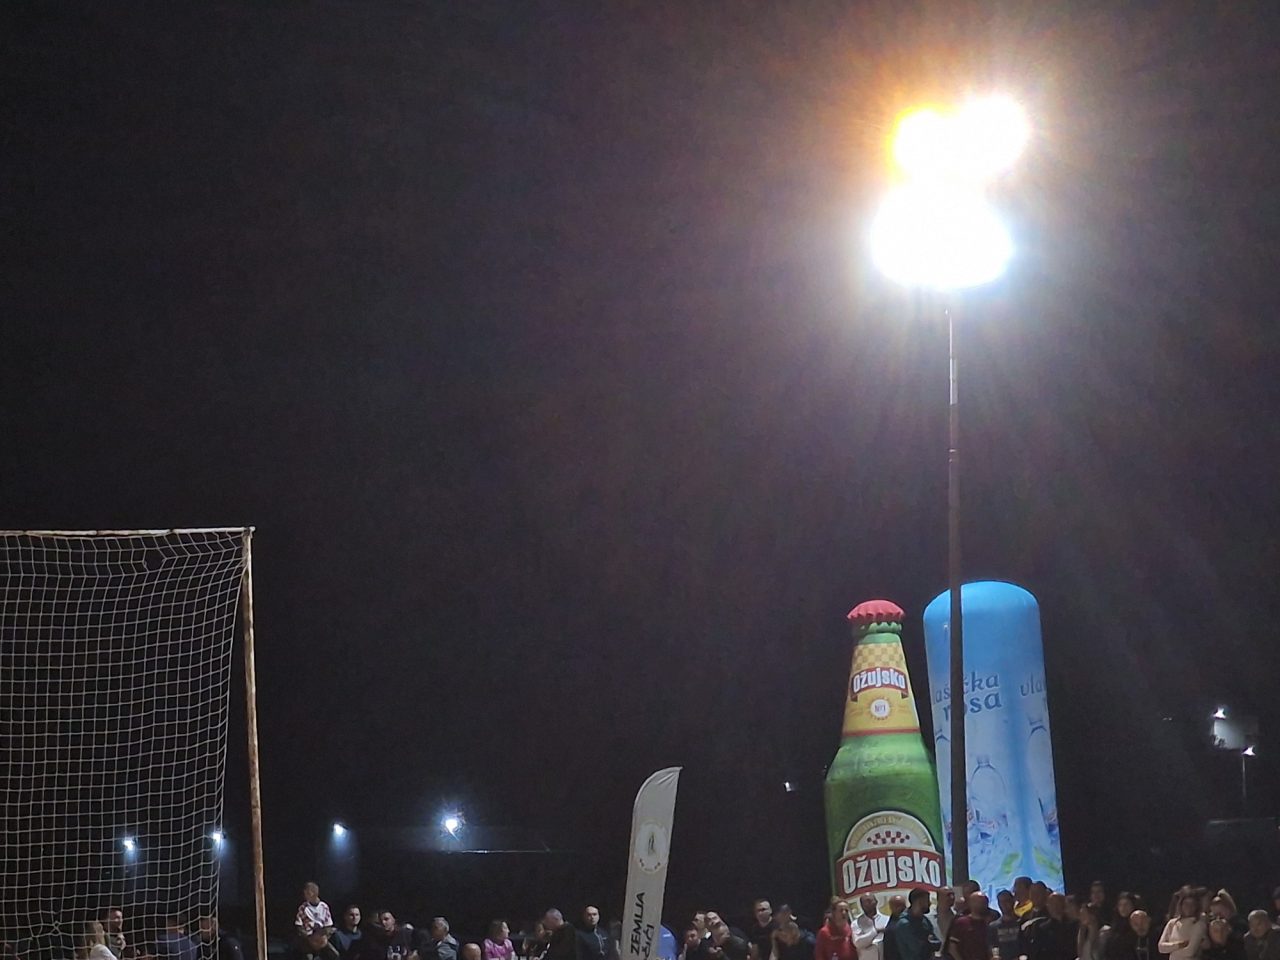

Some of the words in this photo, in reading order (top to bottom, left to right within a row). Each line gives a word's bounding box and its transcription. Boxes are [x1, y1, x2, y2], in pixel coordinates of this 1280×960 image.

[853, 668, 906, 694] Ožujsko
[943, 692, 1003, 721] rsa
[842, 852, 941, 894] Ožujsko
